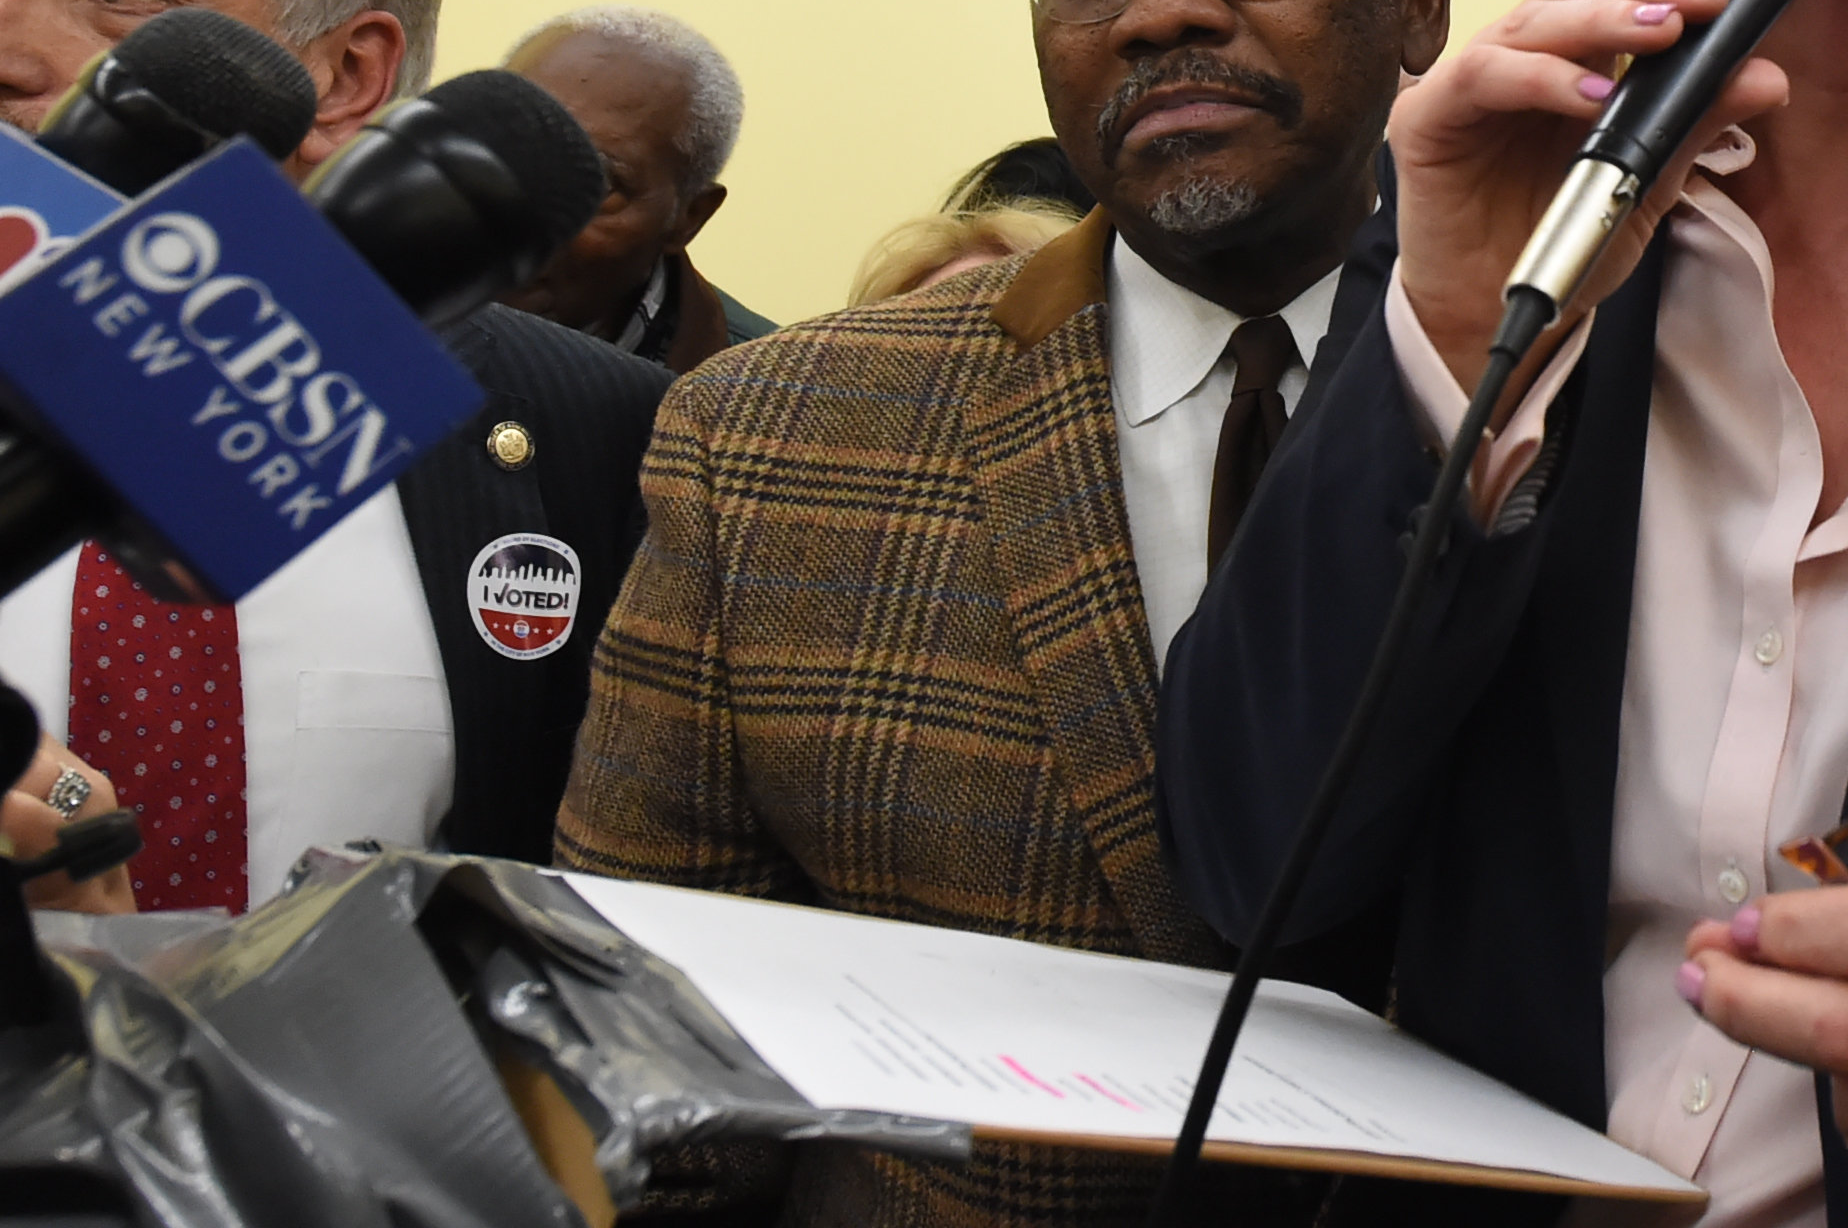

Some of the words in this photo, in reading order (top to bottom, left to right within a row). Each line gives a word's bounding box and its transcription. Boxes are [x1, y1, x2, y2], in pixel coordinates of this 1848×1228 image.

[58, 258, 196, 377] NEW
[191, 384, 334, 530] YORK
[179, 273, 413, 497] CBSN
[483, 584, 489, 603] I
